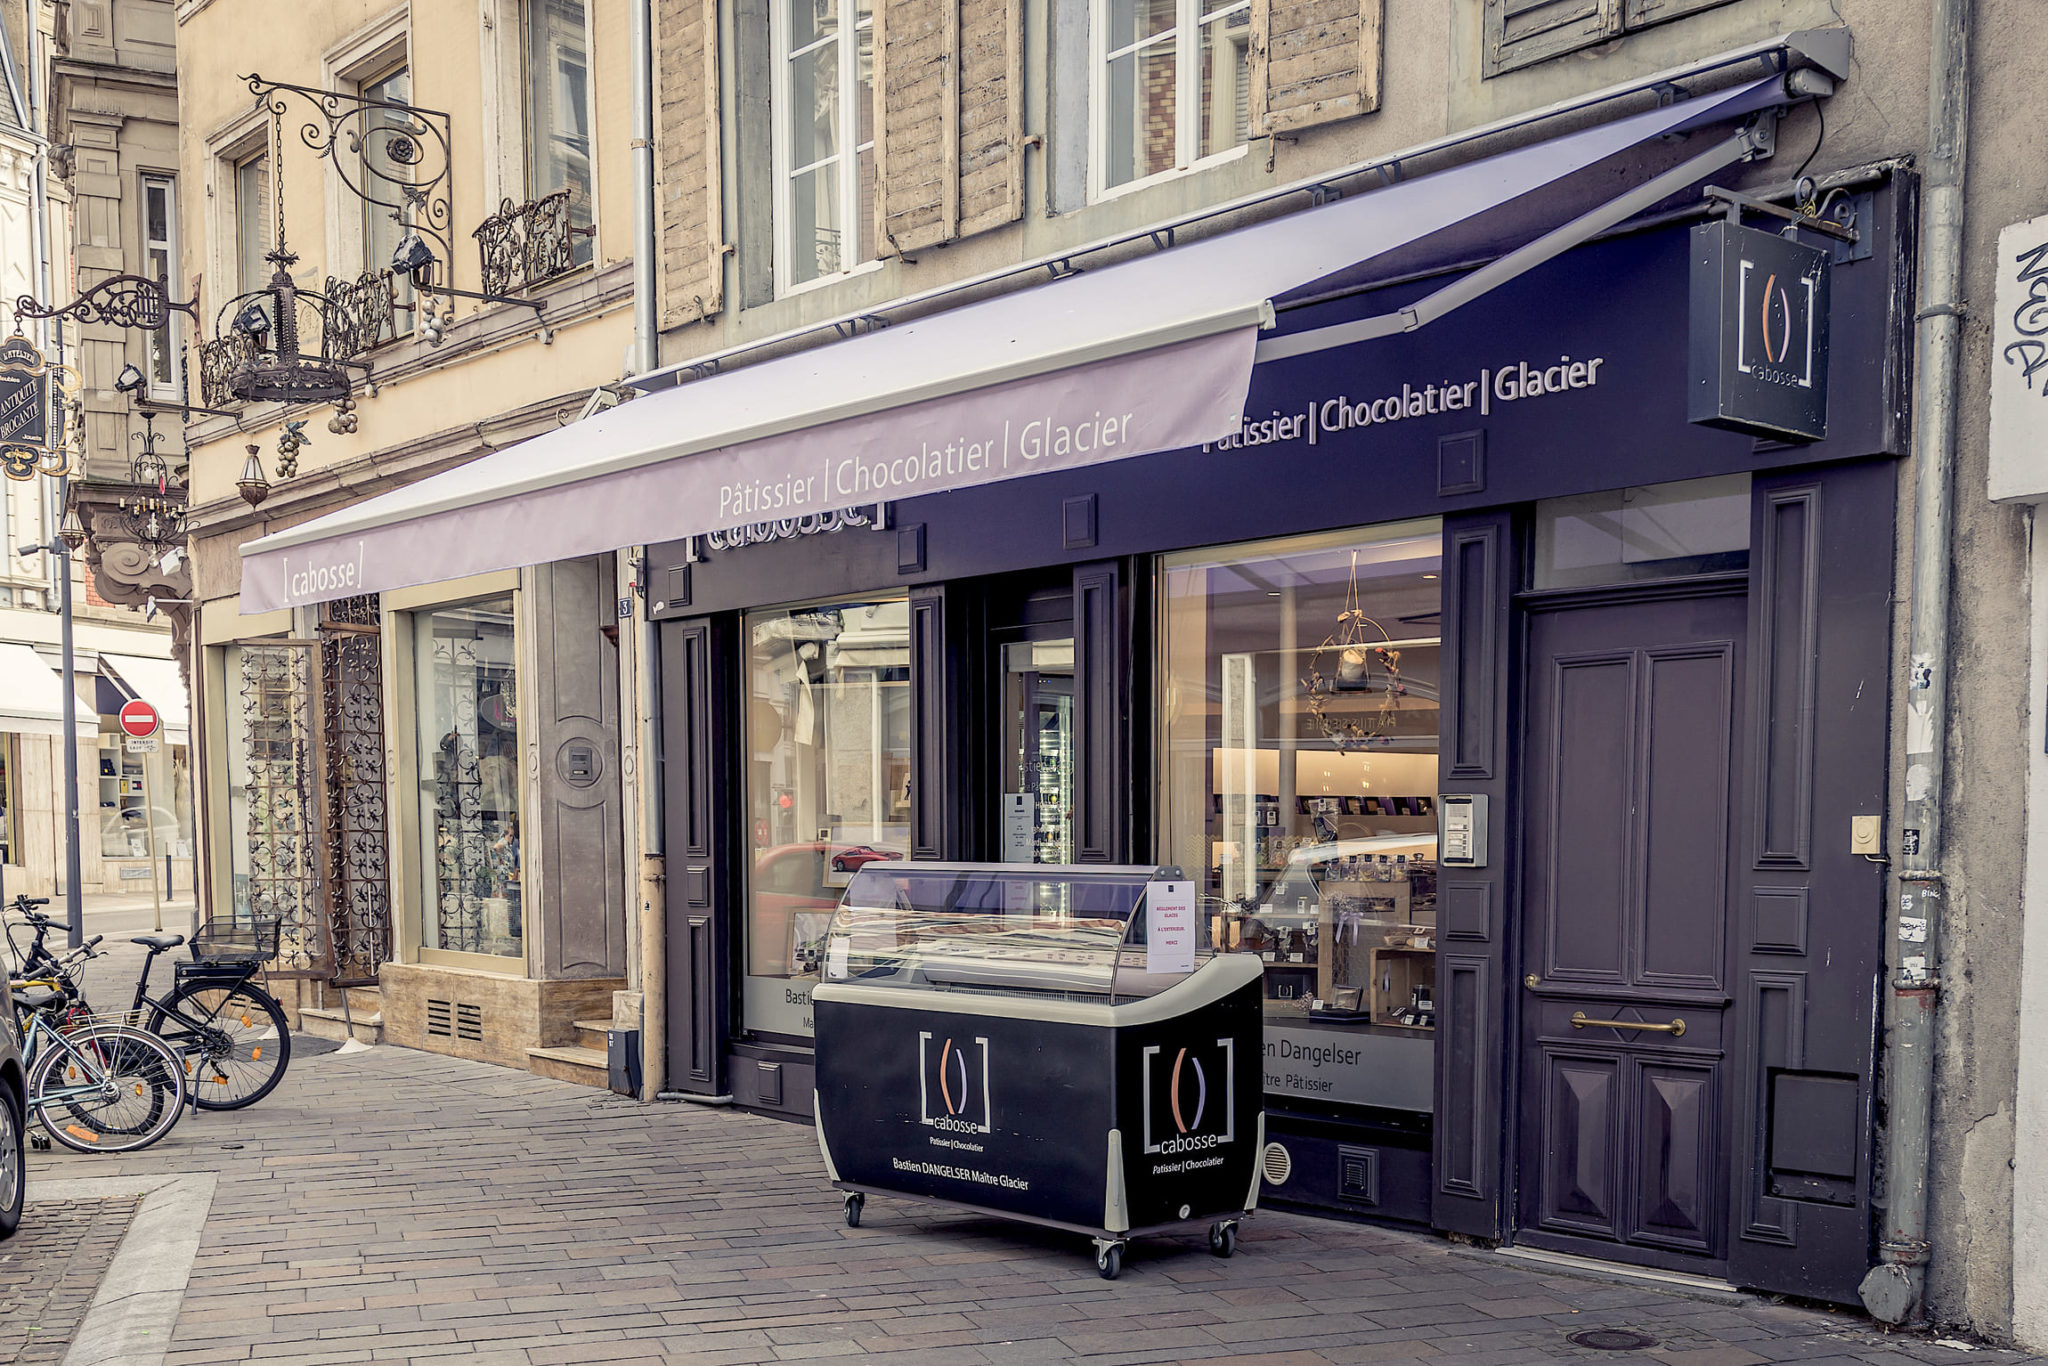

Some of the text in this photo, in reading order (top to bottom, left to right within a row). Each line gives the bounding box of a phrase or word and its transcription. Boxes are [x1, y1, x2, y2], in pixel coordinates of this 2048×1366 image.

[1752, 365, 1798, 387] cabosse
[1320, 379, 1477, 431] Chocolatier
[1494, 355, 1604, 401] Glacier
[0, 401, 39, 438] BROCANTE
[720, 473, 815, 518] Pâtissier
[836, 436, 994, 496] Chocolatier
[1020, 411, 1133, 460] Glacier
[1281, 1039, 1362, 1068] Dangelser
[1286, 1074, 1334, 1093] Pâtissier
[934, 1114, 978, 1135] cabosse
[1161, 1133, 1217, 1154] cabosse
[893, 1157, 922, 1173] Bastien
[922, 1162, 971, 1181] DANGELSER
[999, 1174, 1029, 1191] Glacier
[1185, 1156, 1225, 1170] Chocolatier
